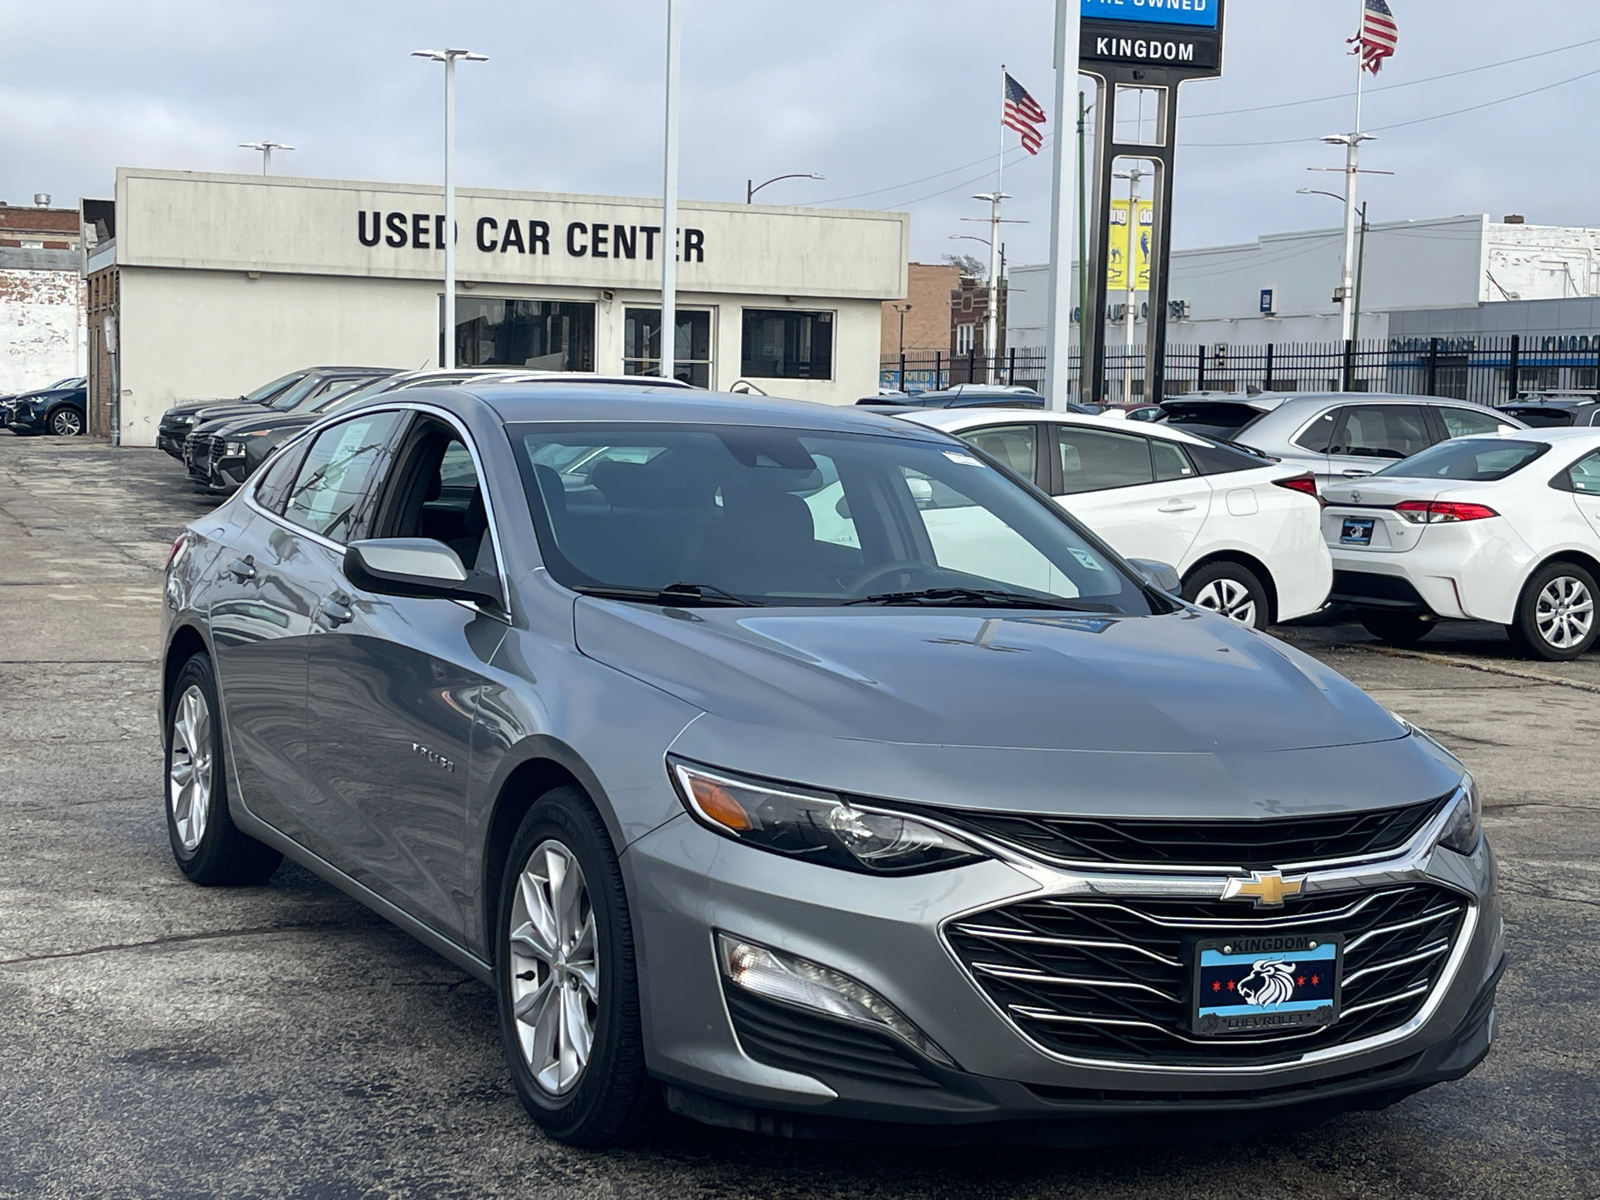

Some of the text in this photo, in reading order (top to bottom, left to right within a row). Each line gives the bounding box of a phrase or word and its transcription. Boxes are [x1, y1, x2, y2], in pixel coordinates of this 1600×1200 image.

[1096, 37, 1194, 61] KINGDOM
[1109, 206, 1127, 226] ing
[1139, 206, 1153, 226] do
[358, 210, 705, 263] USED CAR CENTR
[1232, 936, 1309, 952] KINGDOM
[1228, 1012, 1306, 1029] CHEVROLET
